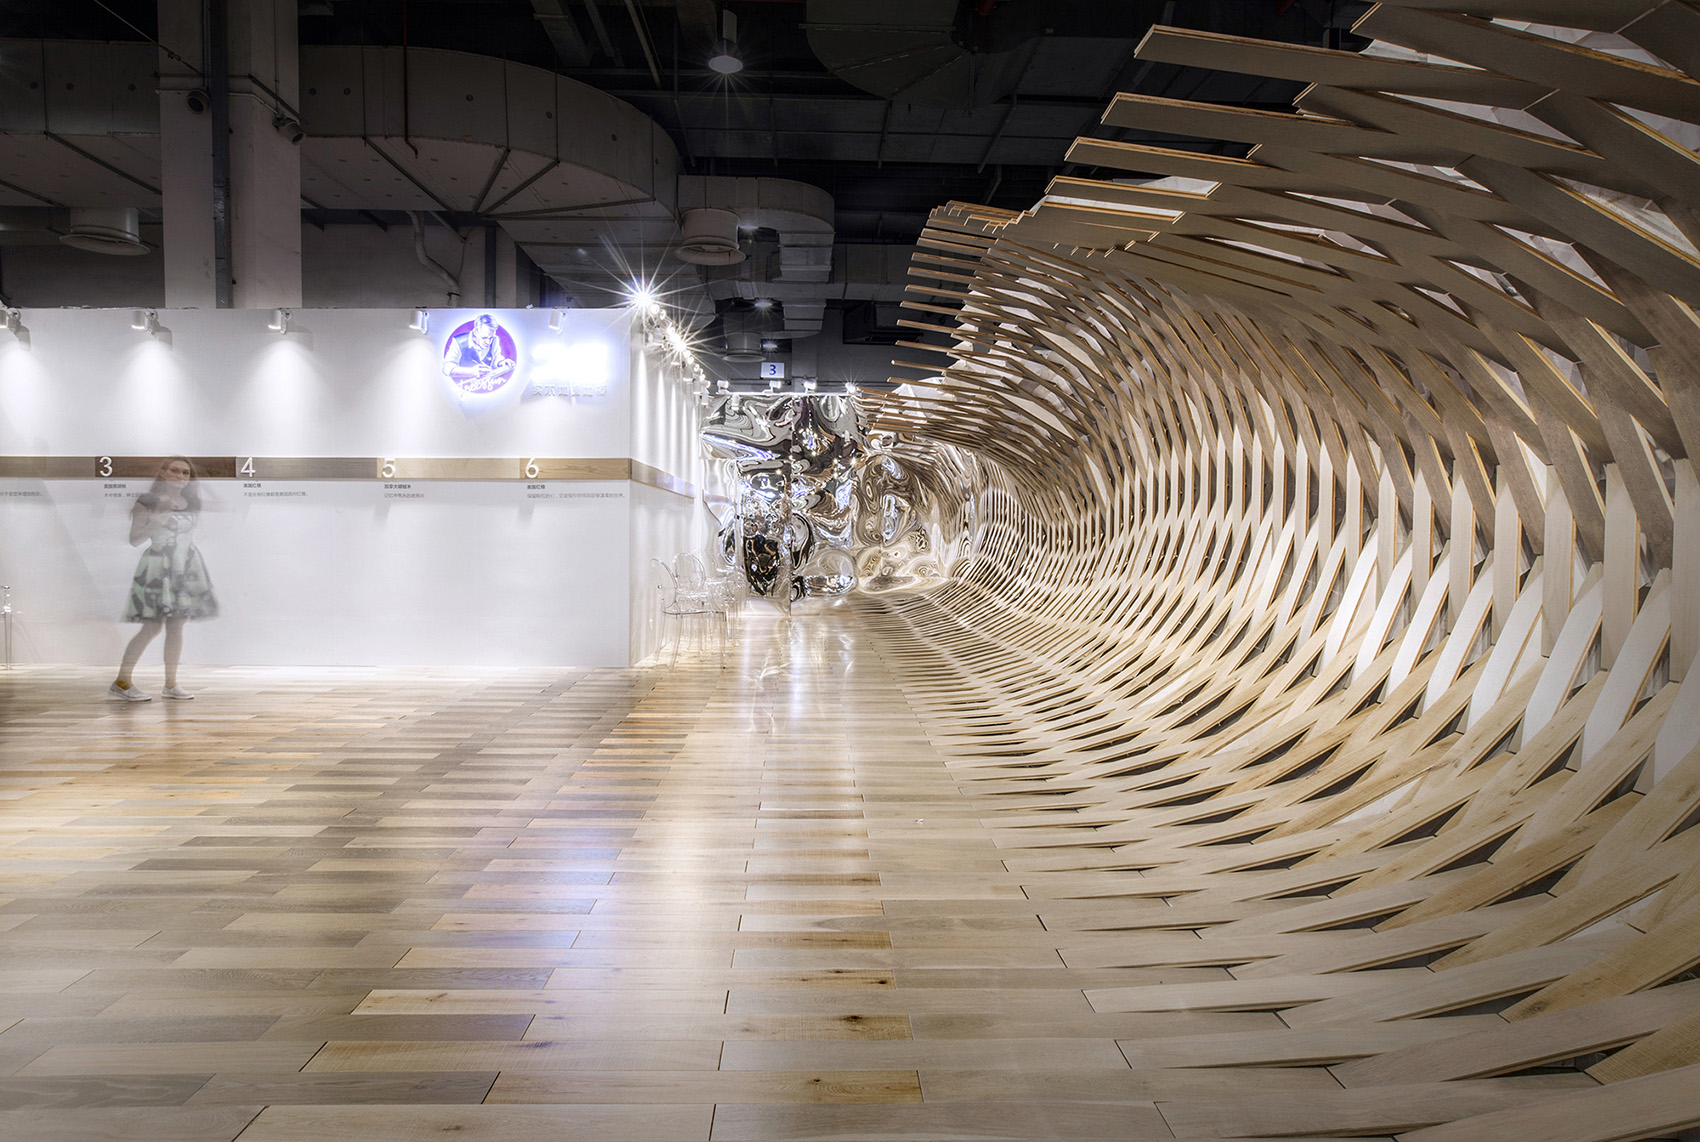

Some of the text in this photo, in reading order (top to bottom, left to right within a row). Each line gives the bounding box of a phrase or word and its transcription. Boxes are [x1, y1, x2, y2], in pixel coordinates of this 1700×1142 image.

[769, 364, 777, 376] 3
[99, 456, 113, 477] 3
[240, 456, 256, 478] 4
[382, 457, 396, 478] 5
[525, 456, 539, 478] 6
